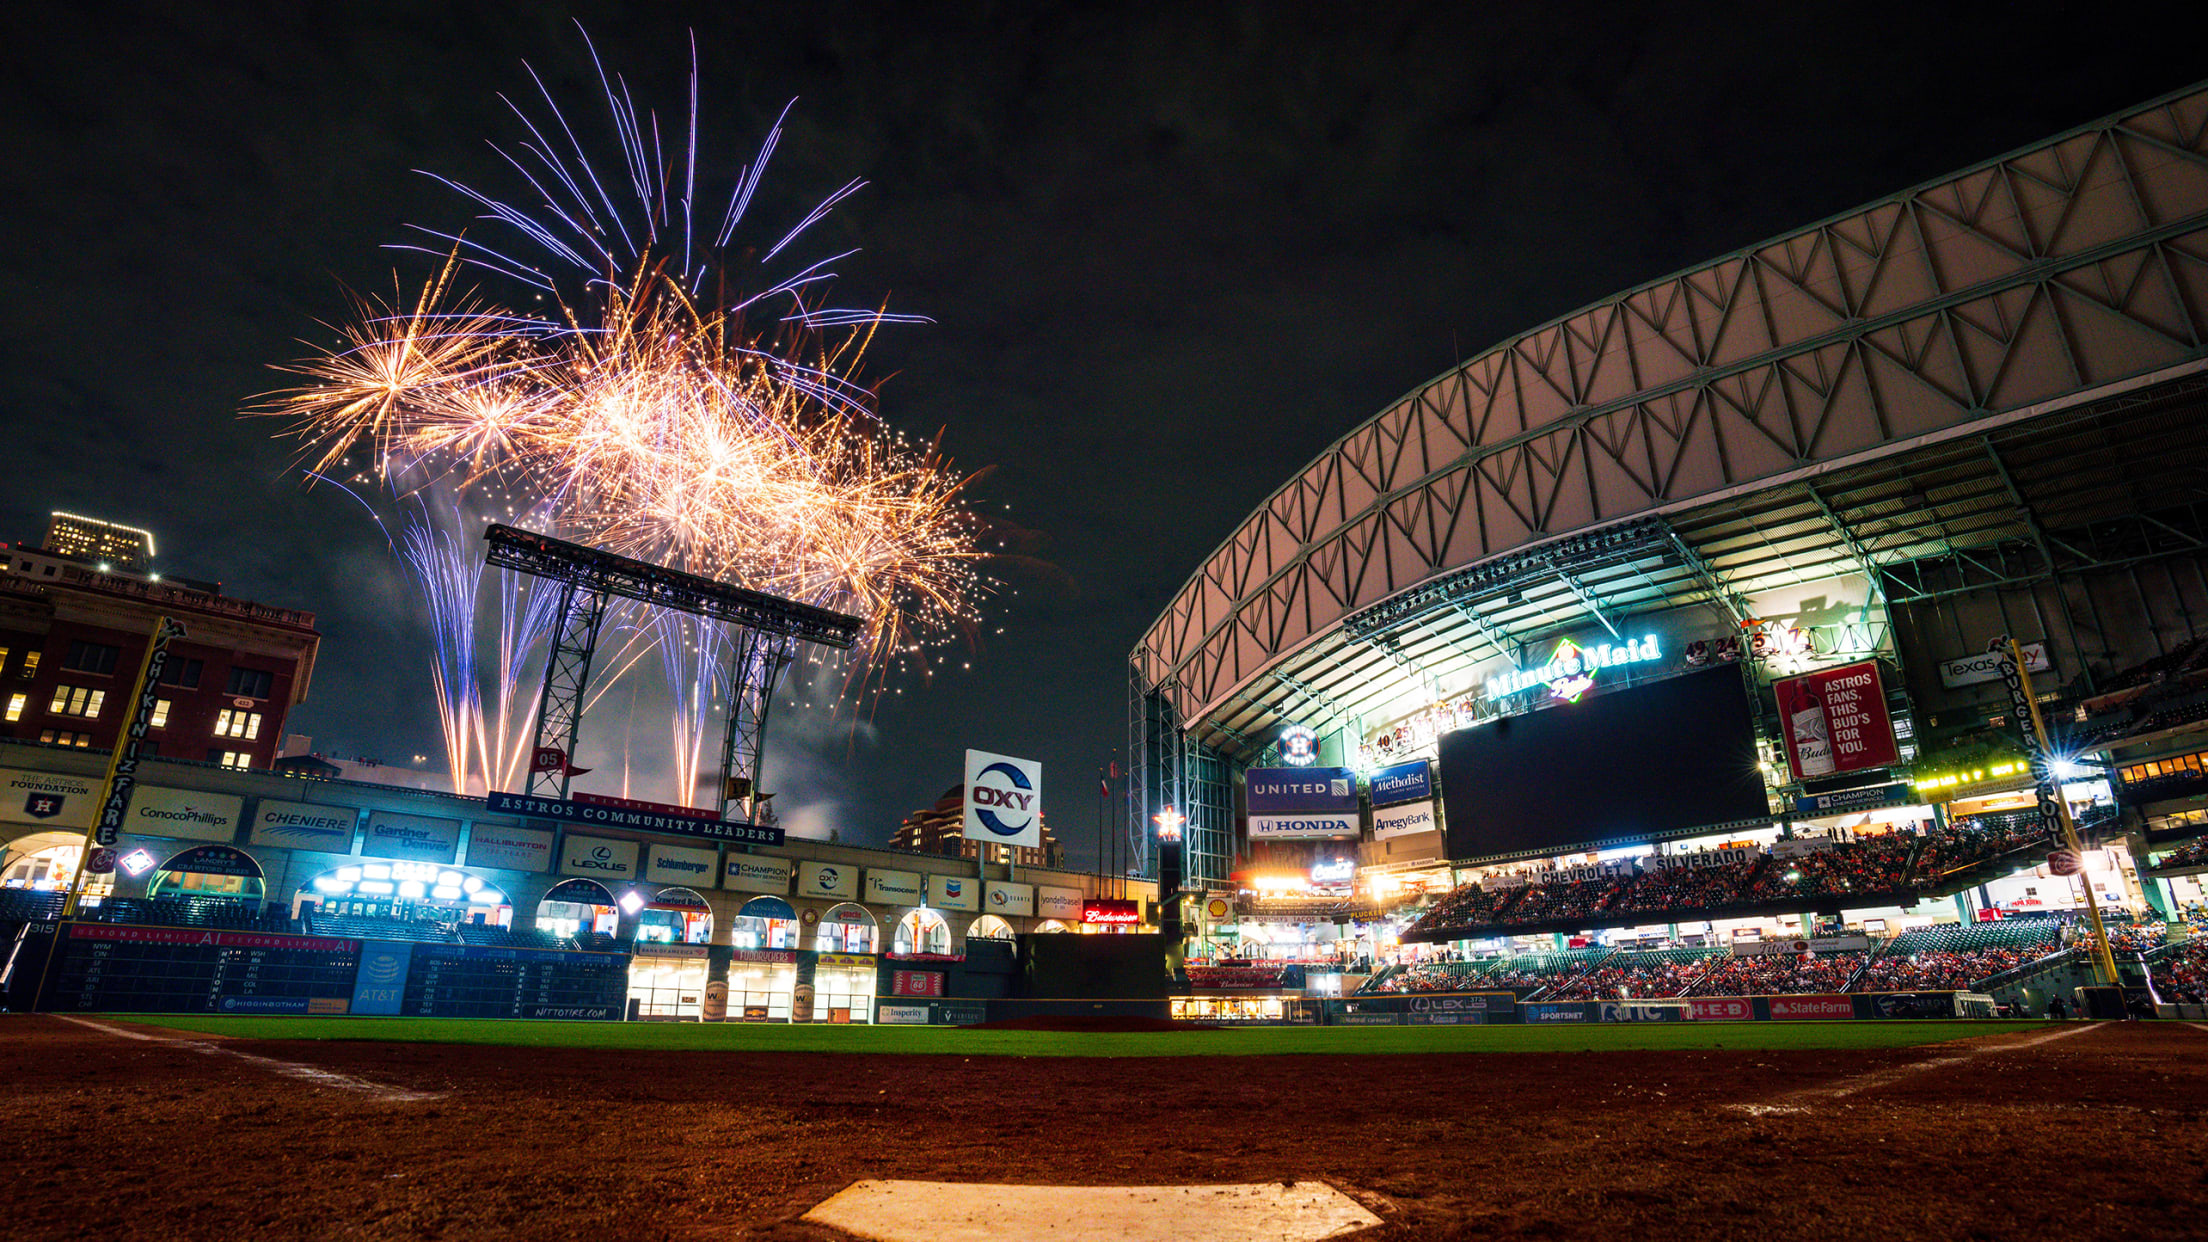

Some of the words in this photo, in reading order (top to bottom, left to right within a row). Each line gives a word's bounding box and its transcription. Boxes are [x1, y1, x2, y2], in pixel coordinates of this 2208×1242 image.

[1754, 632, 1765, 647] 5
[1788, 627, 1800, 642] 7
[1715, 634, 1738, 653] 24
[1487, 658, 1581, 701] Minute
[1583, 634, 1661, 671] Maid
[1944, 659, 1995, 676] Texas
[1825, 673, 1872, 692] ASTROS
[132, 651, 166, 736] CHIKIN
[1828, 690, 1862, 704] FANS.
[1829, 702, 1858, 717] THIS
[1832, 713, 1870, 730] BUD'S
[1377, 735, 1390, 748] 40
[1836, 728, 1860, 742] FOR
[1838, 740, 1867, 755] YOU.
[538, 752, 558, 766] 05
[11, 780, 88, 794] FOUNDATION
[1255, 784, 1326, 794] UNITED
[1376, 773, 1424, 792] Methodist
[973, 786, 1034, 810] OXY
[1832, 789, 1884, 801] CHAMPION
[102, 777, 131, 843] FARE
[589, 796, 653, 810] MINUTE
[668, 807, 707, 817] MAID
[140, 806, 227, 826] ConocoPhillips
[265, 812, 349, 829] CHENIERE
[500, 798, 575, 817] ASTROS
[583, 808, 696, 832] COMMUNITY
[704, 823, 776, 842] LEADERS
[1376, 812, 1430, 831] AmegyBank
[2038, 786, 2064, 848] FOUL
[375, 824, 430, 839] Gardner
[1275, 820, 1350, 830] HONDA
[402, 838, 450, 851] Denver
[476, 837, 547, 850] HALLIBURTON
[572, 858, 627, 872] LEXUS
[657, 858, 708, 874] Schlumberger
[1656, 850, 1746, 870] SILVERADO
[741, 864, 788, 876] CHAMPION
[1542, 865, 1622, 884] CHEVROLET
[878, 884, 918, 894] Transocean
[1085, 911, 1138, 922] Budweiser
[29, 924, 55, 933] 315
[1760, 942, 1792, 953] Tito's
[739, 950, 789, 961] FUDDRUCKERS
[208, 951, 228, 1007] NATIONAL
[359, 989, 399, 1001] AT&T
[535, 1007, 607, 1018] NITTOTIRE.COM
[891, 1008, 921, 1017] Insperity
